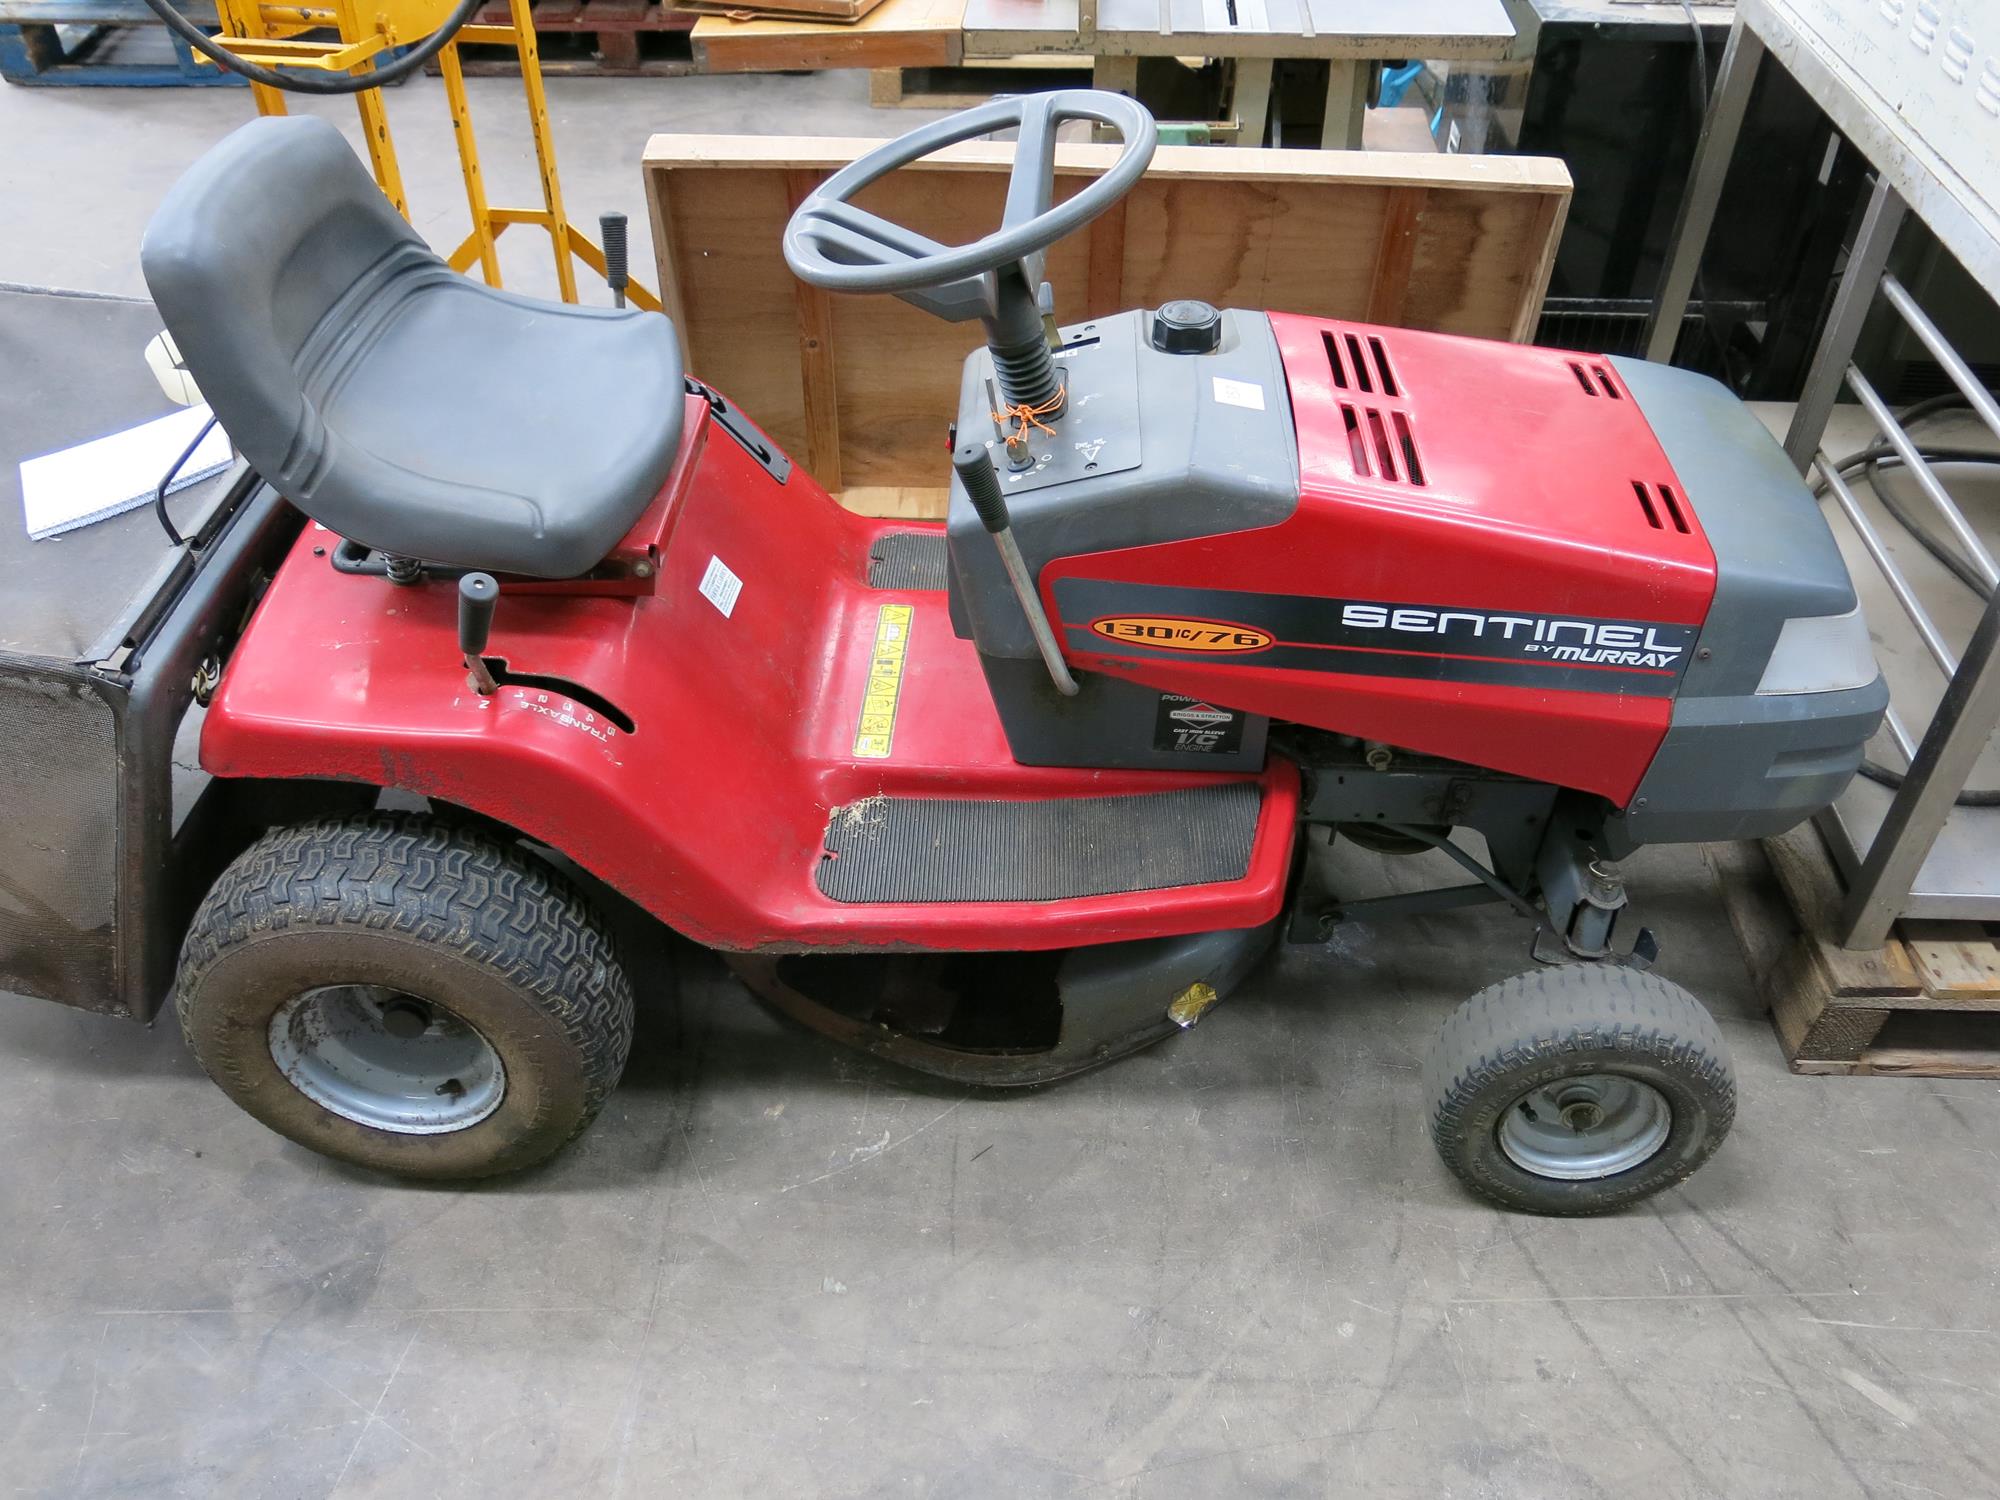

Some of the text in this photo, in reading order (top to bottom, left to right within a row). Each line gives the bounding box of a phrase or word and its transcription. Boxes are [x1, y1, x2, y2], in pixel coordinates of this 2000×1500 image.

[1342, 605, 1682, 652] SENTINEL
[1524, 644, 1679, 668] BY MURRAY
[1161, 694, 1205, 703] POW
[520, 701, 608, 743] TRANSAXLE
[1174, 743, 1214, 752] ENGINE
